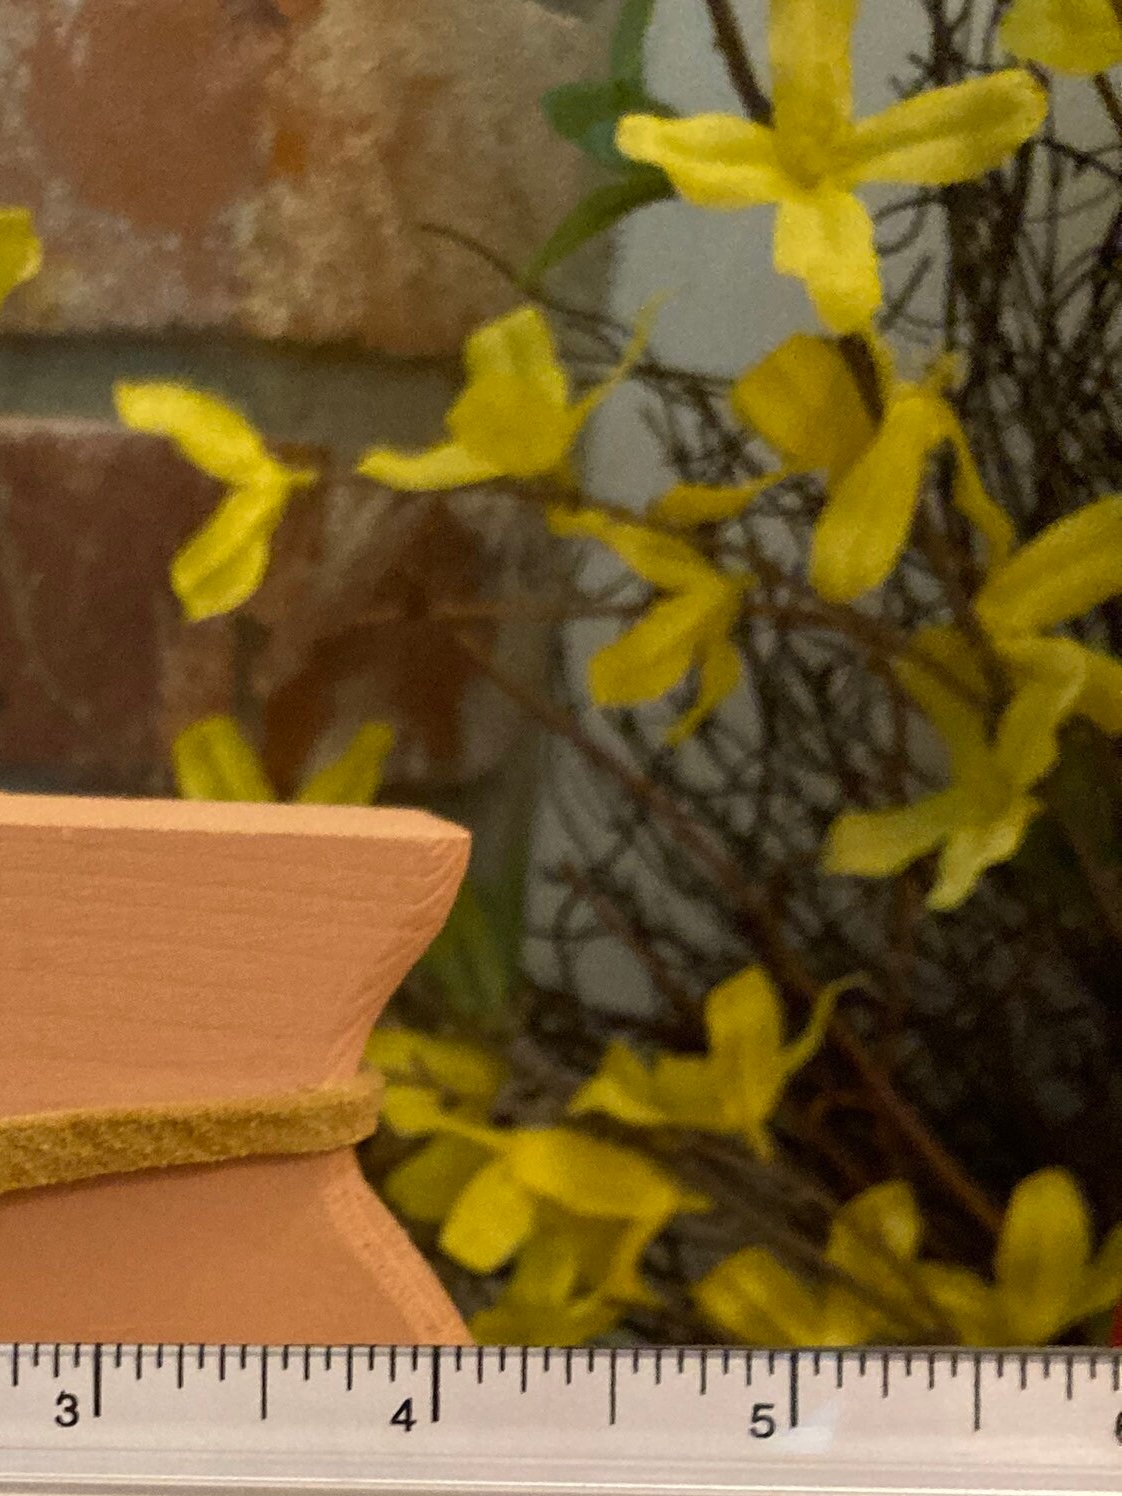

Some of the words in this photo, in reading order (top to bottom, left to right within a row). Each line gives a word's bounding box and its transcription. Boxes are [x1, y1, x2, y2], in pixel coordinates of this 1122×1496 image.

[54, 1393, 80, 1427] 3
[389, 1398, 417, 1432] 4
[749, 1403, 776, 1439] 5
